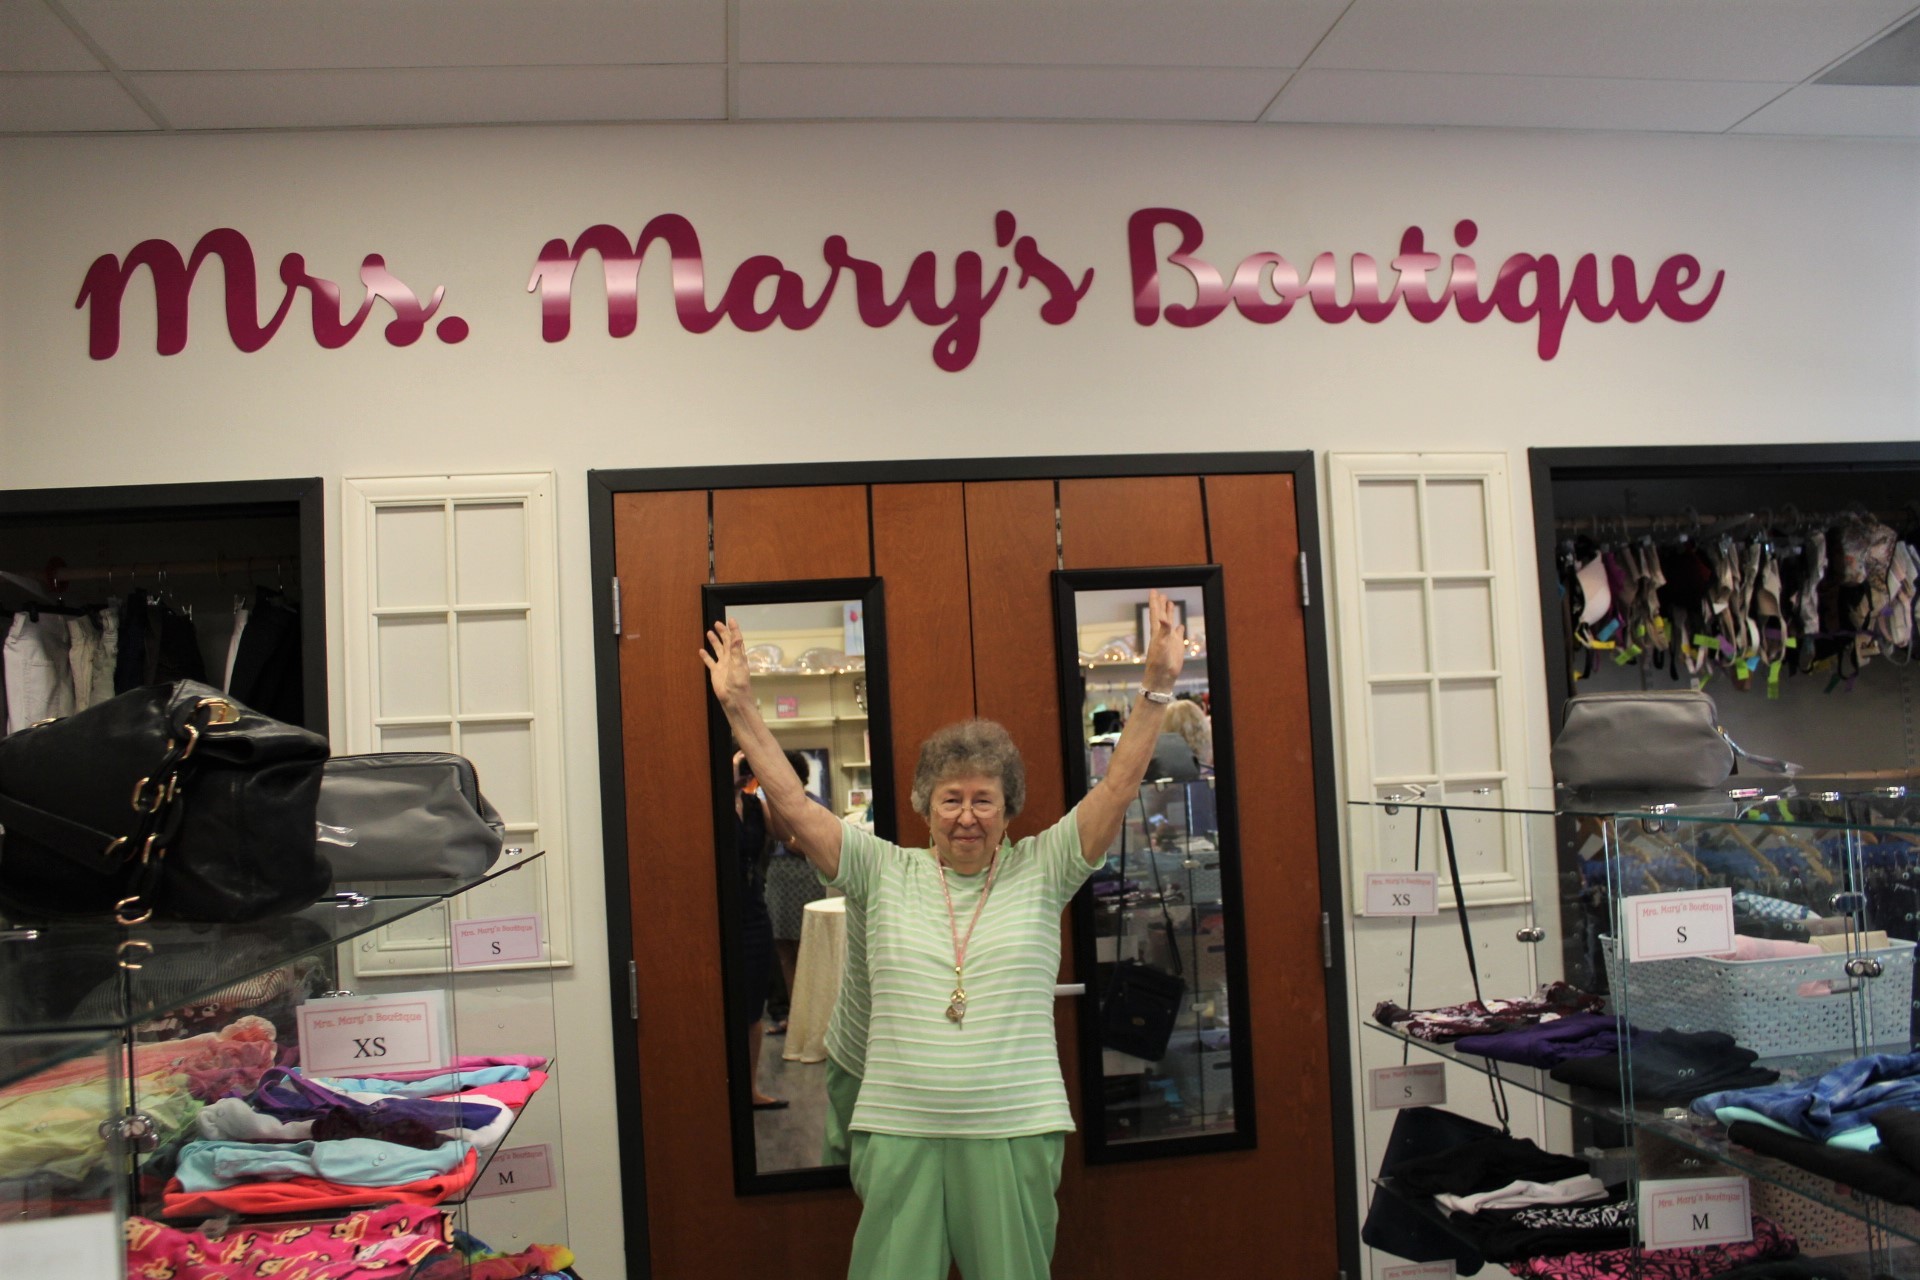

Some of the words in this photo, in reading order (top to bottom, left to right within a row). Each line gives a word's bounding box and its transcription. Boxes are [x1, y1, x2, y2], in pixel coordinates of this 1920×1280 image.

[75, 227, 469, 361] Mrs.
[527, 210, 1094, 372] Mary's
[1128, 207, 1725, 361] Boutique
[1392, 893, 1411, 906] XS
[1689, 903, 1723, 912] Boutique
[1677, 926, 1687, 943] S
[491, 941, 502, 955] S
[376, 1012, 422, 1023] Boutique
[352, 1037, 386, 1058] XS
[1404, 1086, 1412, 1098] S
[499, 1171, 514, 1185] M
[1692, 1212, 1709, 1231] M
